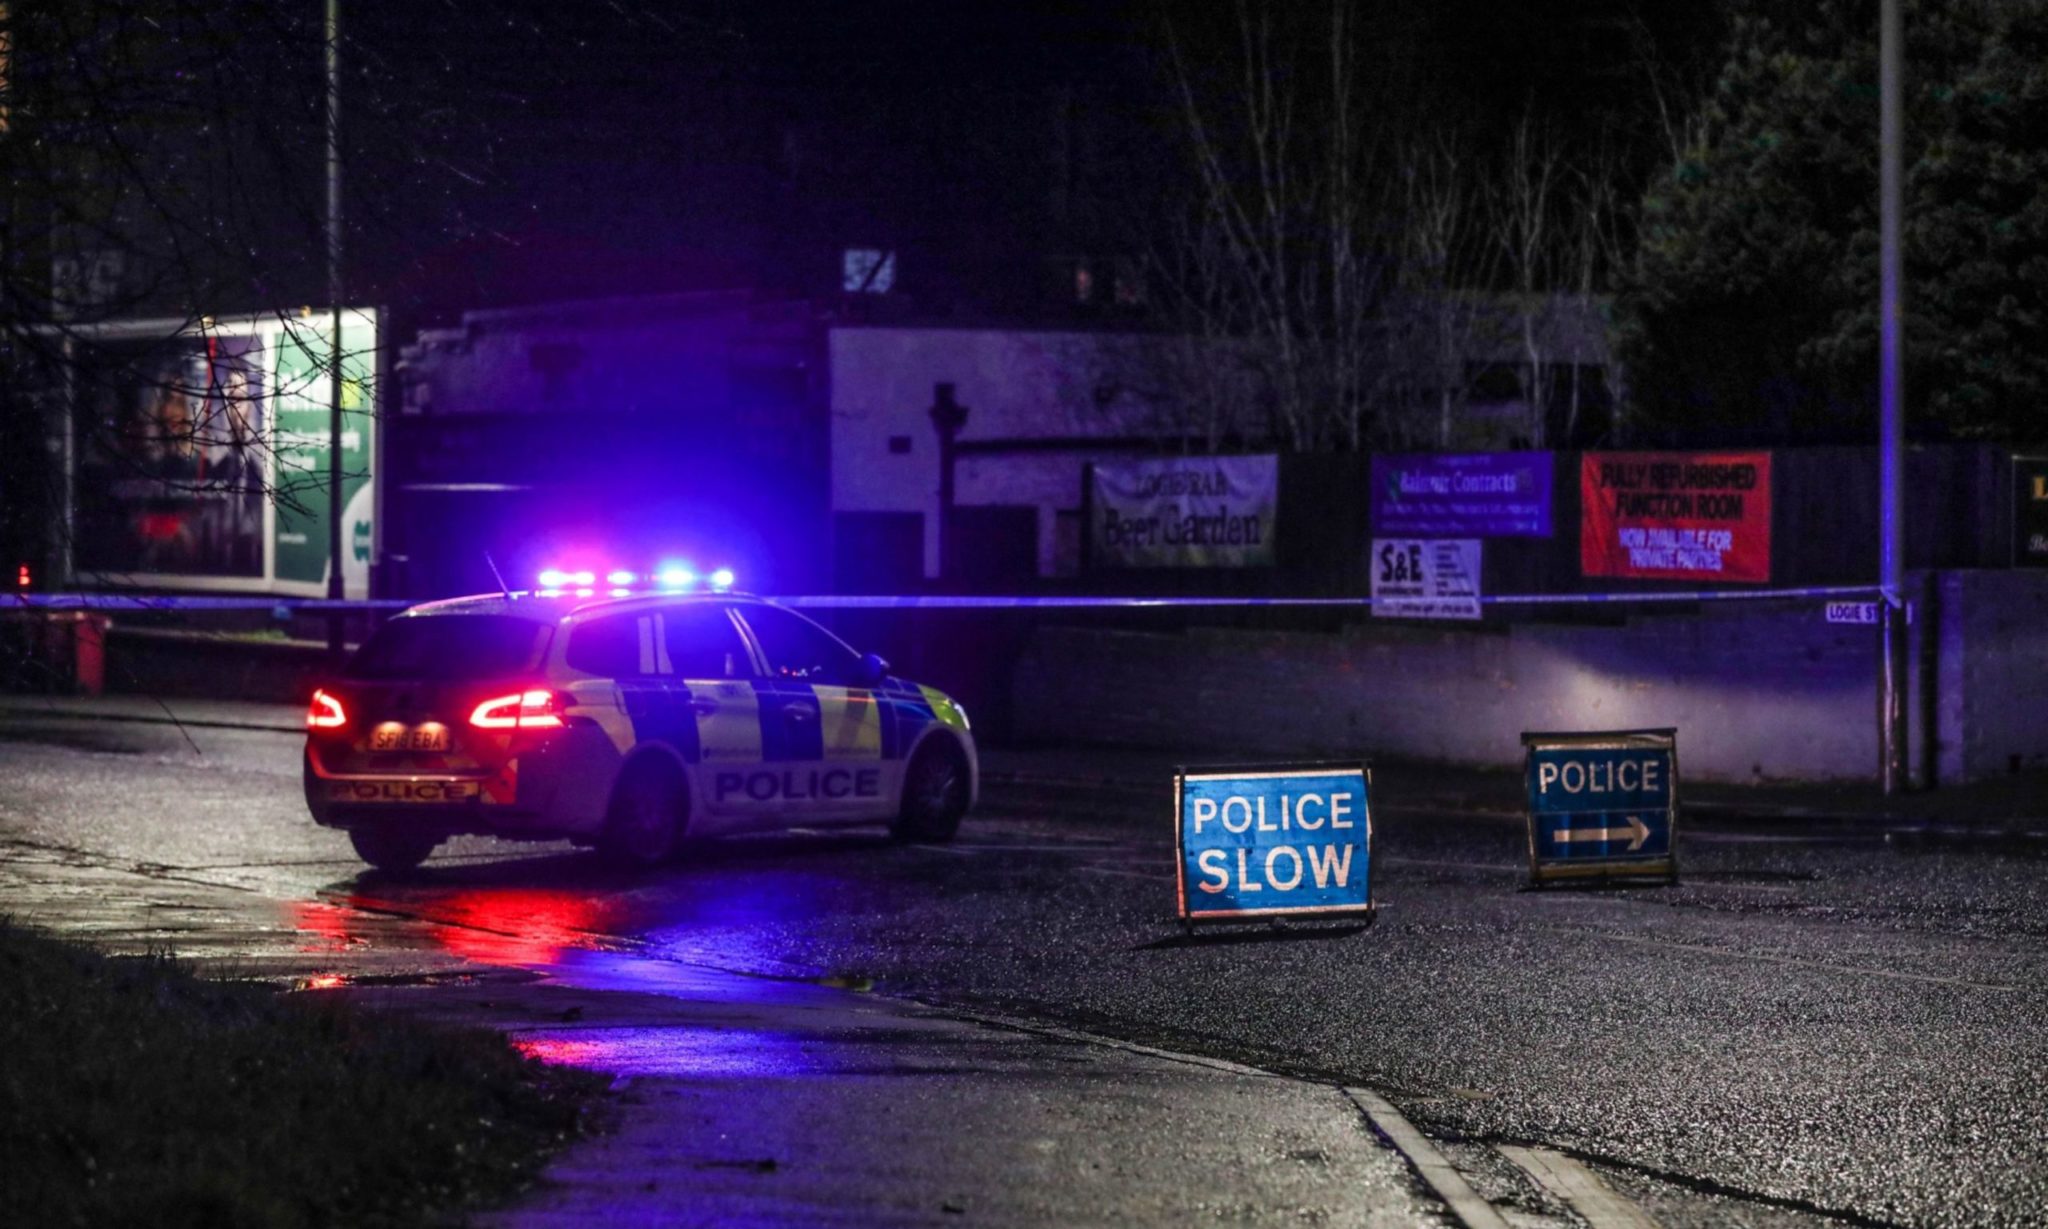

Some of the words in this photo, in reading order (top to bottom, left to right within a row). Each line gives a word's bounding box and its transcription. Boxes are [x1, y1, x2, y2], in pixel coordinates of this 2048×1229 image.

[1453, 469, 1516, 492] Contracts
[1600, 463, 1648, 488] FULLY
[1650, 463, 1757, 490] REFURBISHED
[1616, 493, 1693, 517] FUNCTION
[1697, 494, 1743, 519] ROOM
[1105, 507, 1158, 546] Beer
[1163, 504, 1260, 545] Garden
[1707, 529, 1732, 551] FOR
[1381, 543, 1423, 581] S&E
[1829, 606, 1860, 619] LOGIE
[331, 781, 470, 799] POLICE
[715, 769, 880, 801] POLICE
[1538, 760, 1660, 794] POLICE
[1193, 792, 1354, 834] POLICE
[1197, 843, 1354, 895] SLOW
